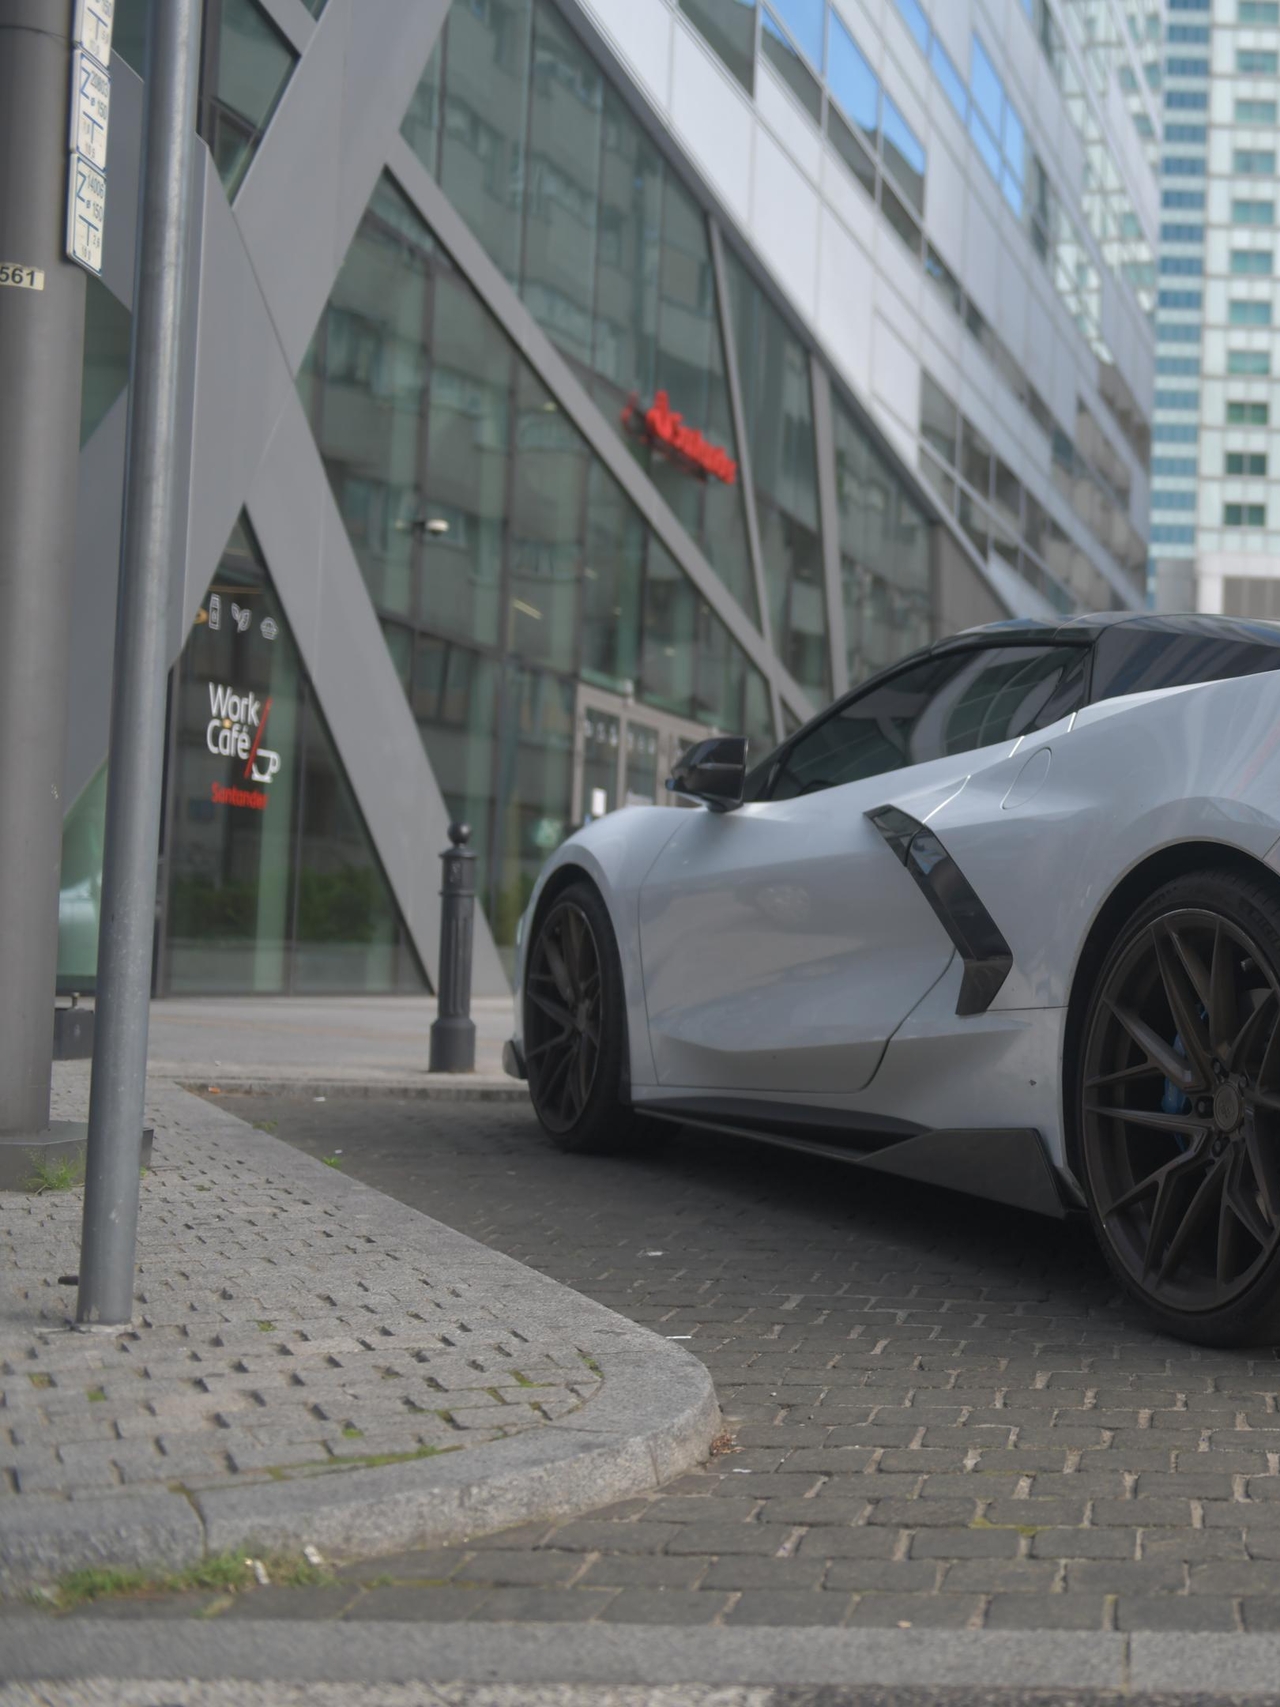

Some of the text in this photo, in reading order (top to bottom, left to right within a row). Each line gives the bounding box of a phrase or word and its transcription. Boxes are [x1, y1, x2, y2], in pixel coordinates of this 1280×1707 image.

[0, 266, 36, 287] 561
[208, 681, 261, 727] Work
[206, 718, 251, 760] Café
[211, 782, 268, 810] Santander
